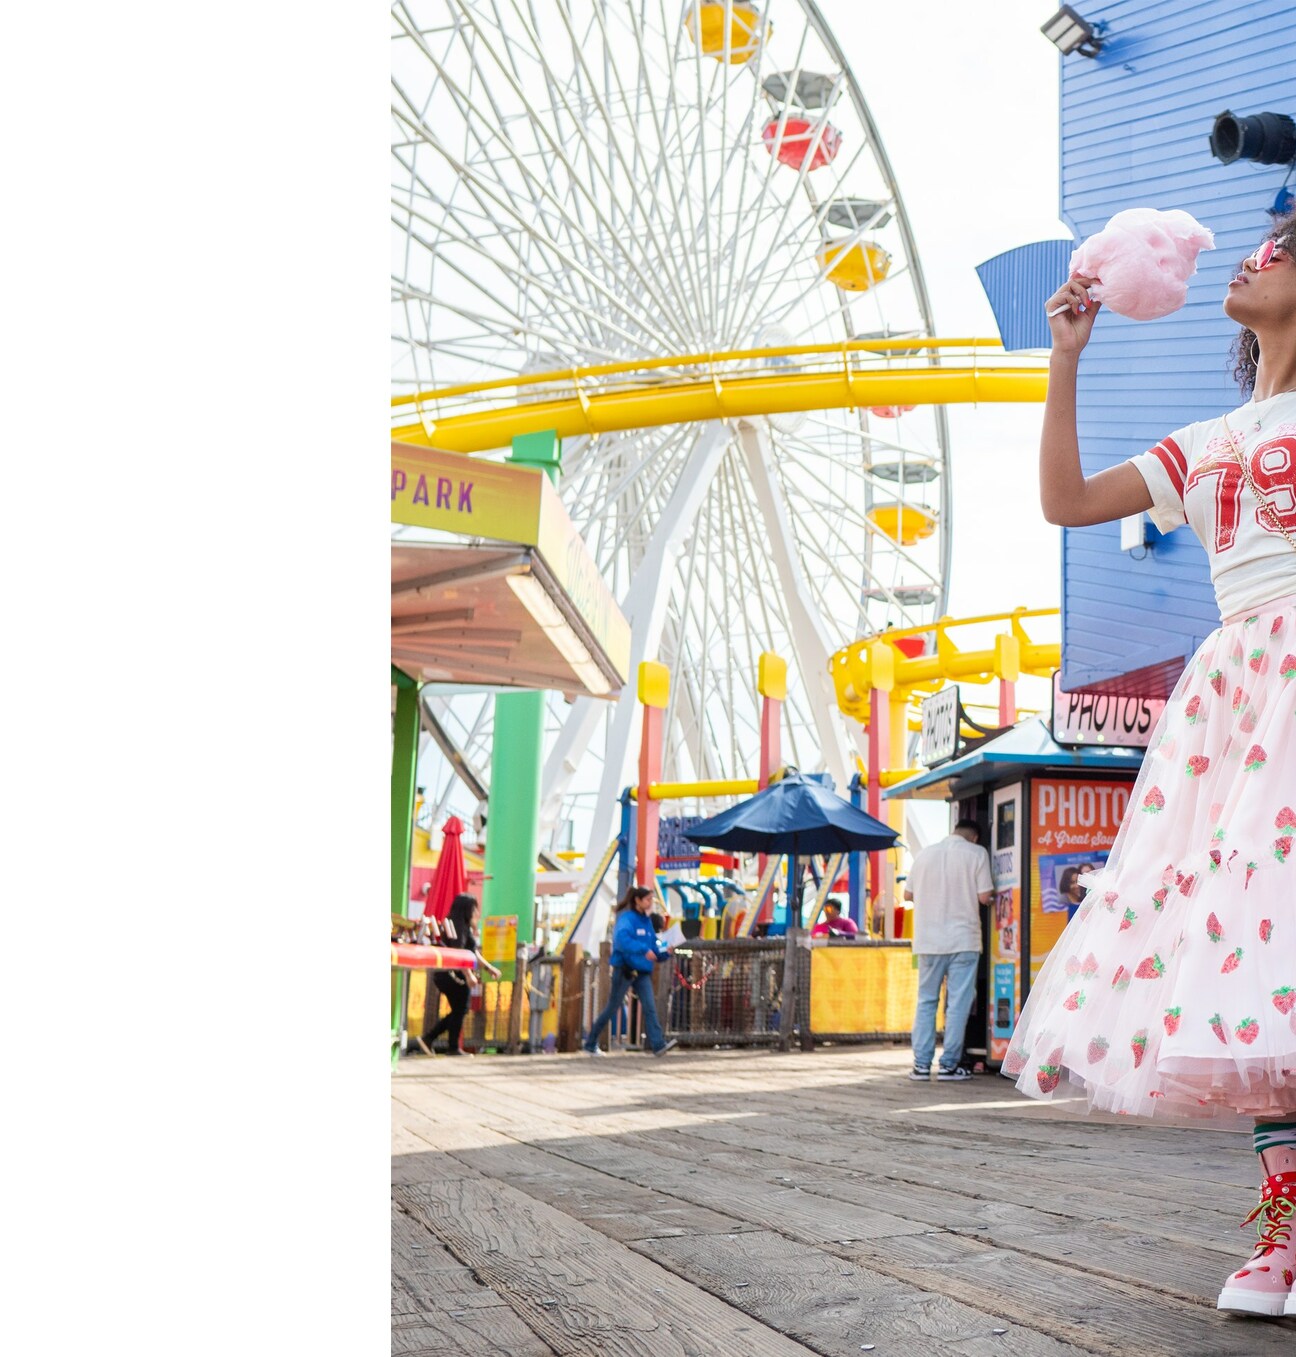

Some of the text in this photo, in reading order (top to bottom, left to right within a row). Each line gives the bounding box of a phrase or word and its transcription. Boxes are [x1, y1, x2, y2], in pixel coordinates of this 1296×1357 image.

[391, 469, 473, 513] PARK
[925, 702, 954, 750] PHOTOS
[1067, 692, 1151, 734] PHOTOS
[1038, 830, 1052, 846] A
[1053, 830, 1090, 848] Great
